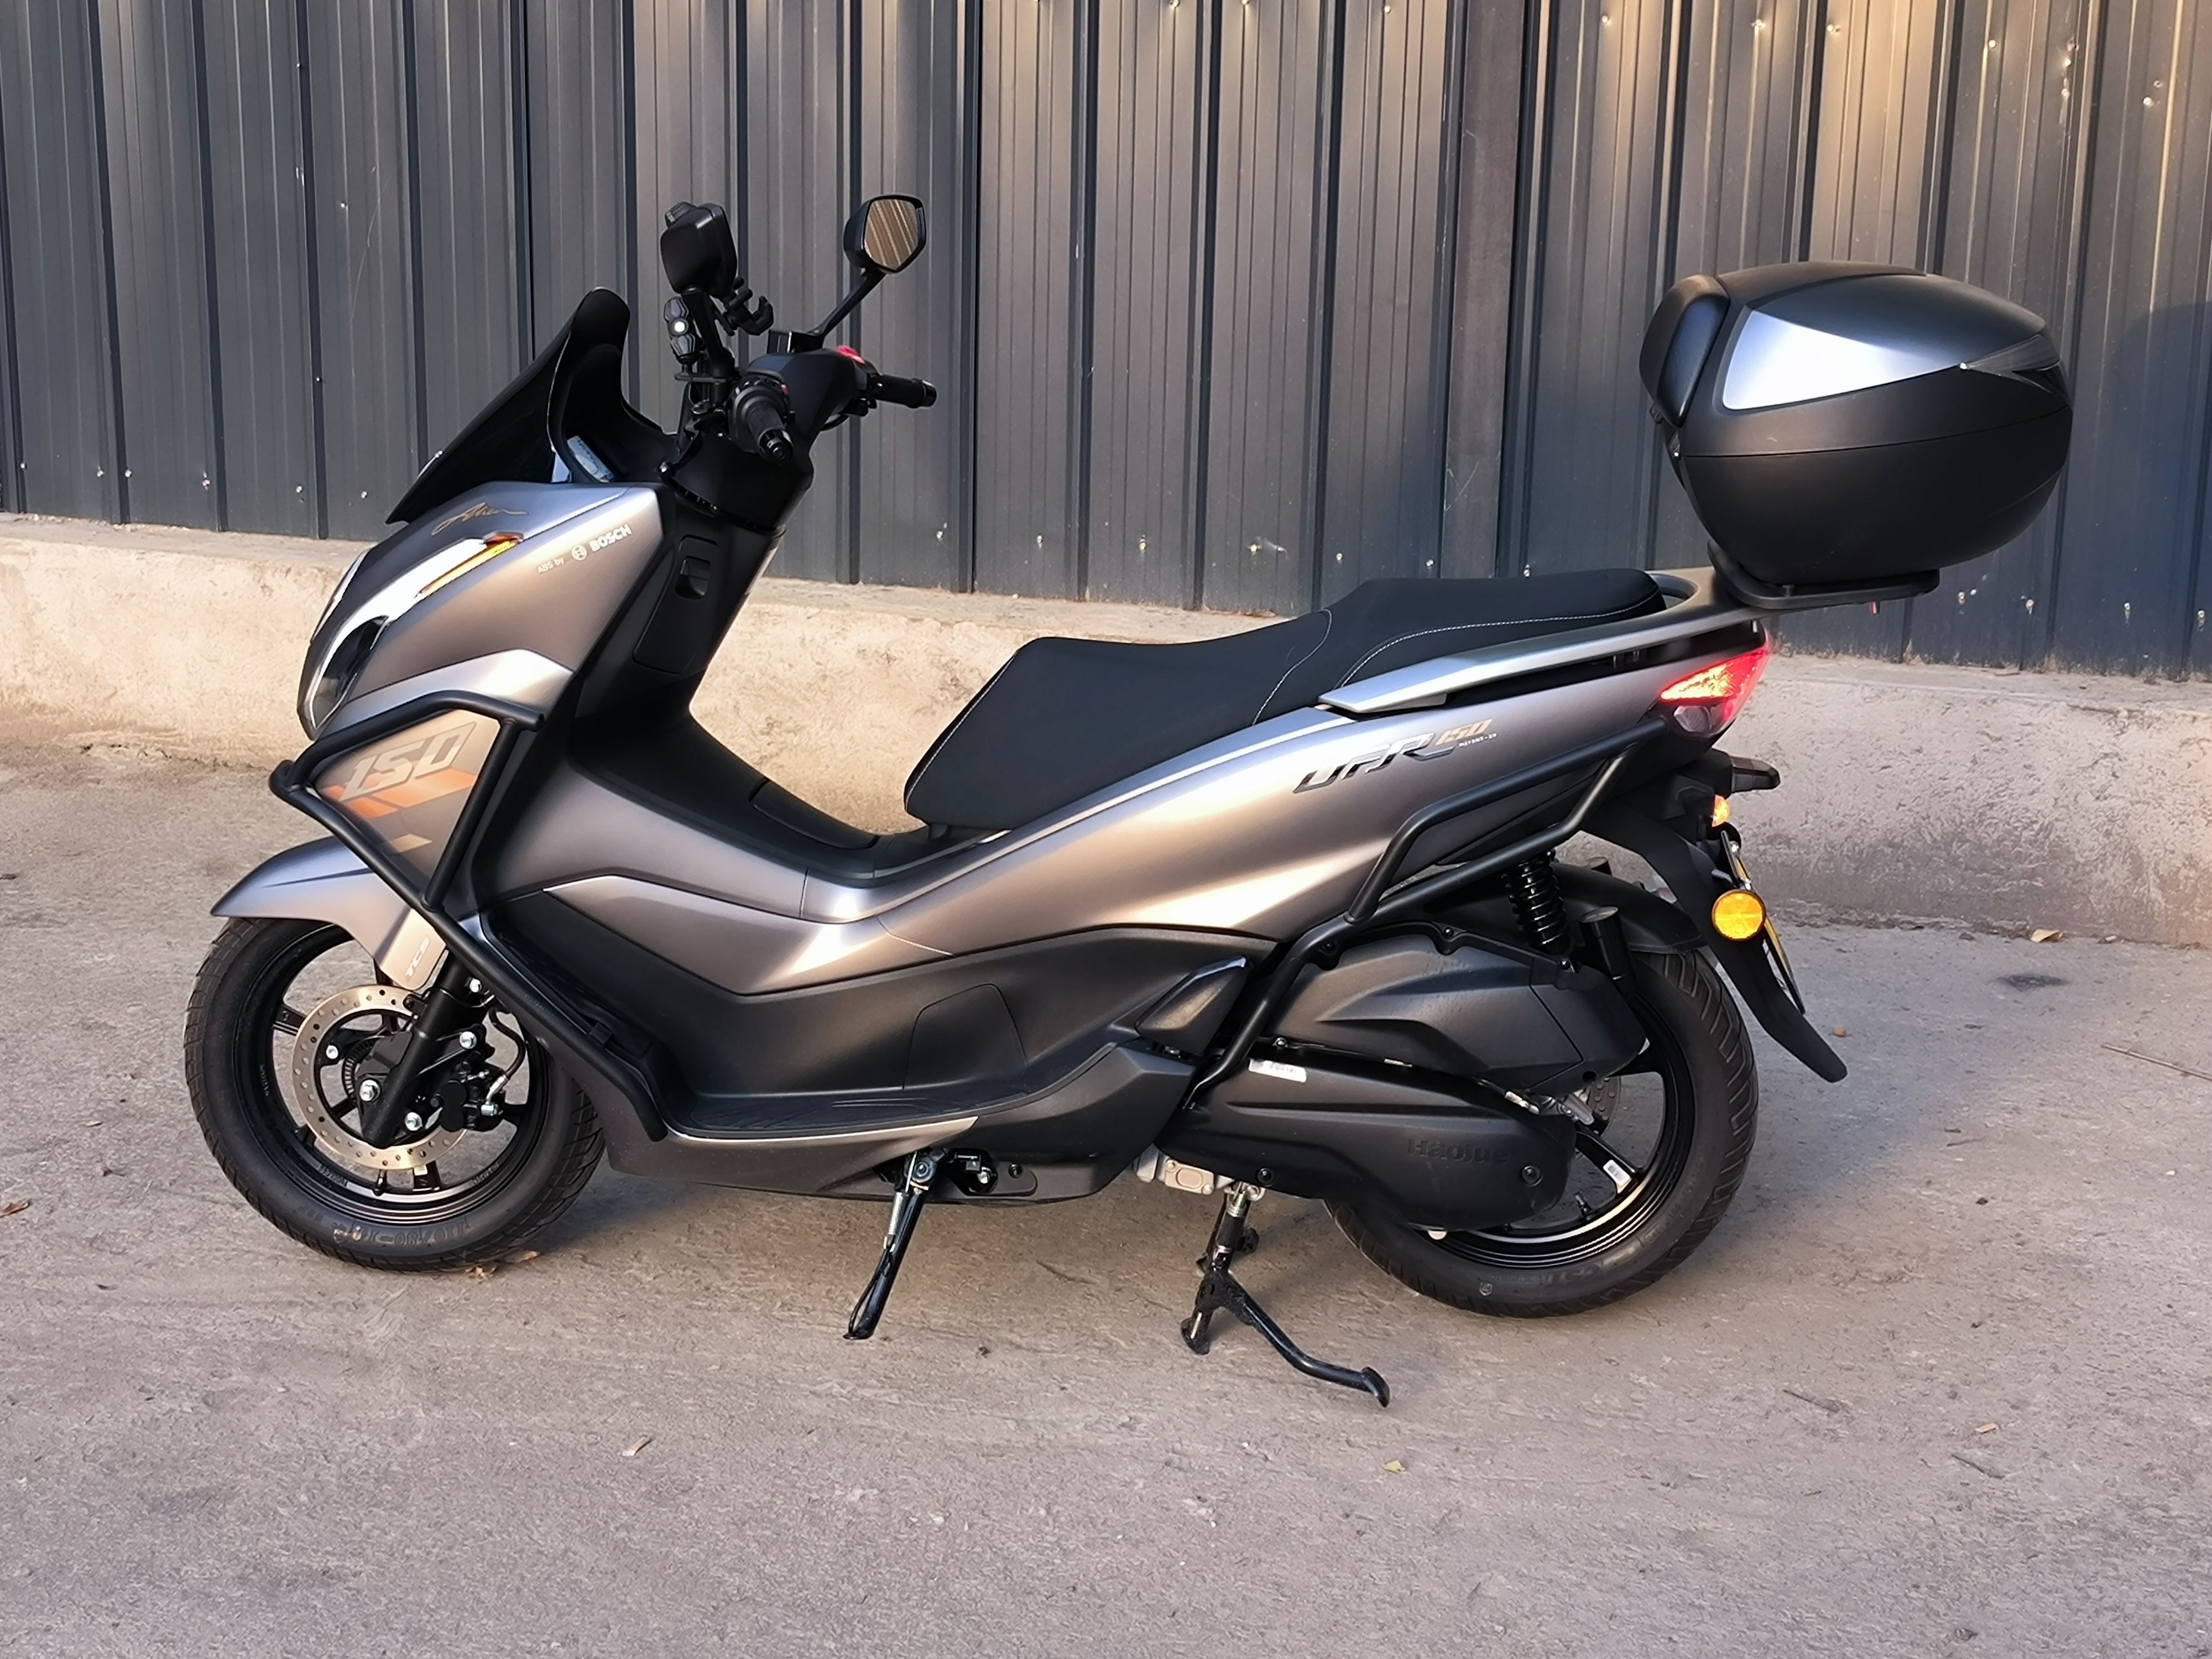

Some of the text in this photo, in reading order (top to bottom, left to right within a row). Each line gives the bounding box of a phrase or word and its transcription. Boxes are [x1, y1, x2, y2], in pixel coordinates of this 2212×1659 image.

[538, 523, 632, 574] ABS by BOSCH
[1434, 718, 1493, 746] 150
[338, 721, 477, 802] 150
